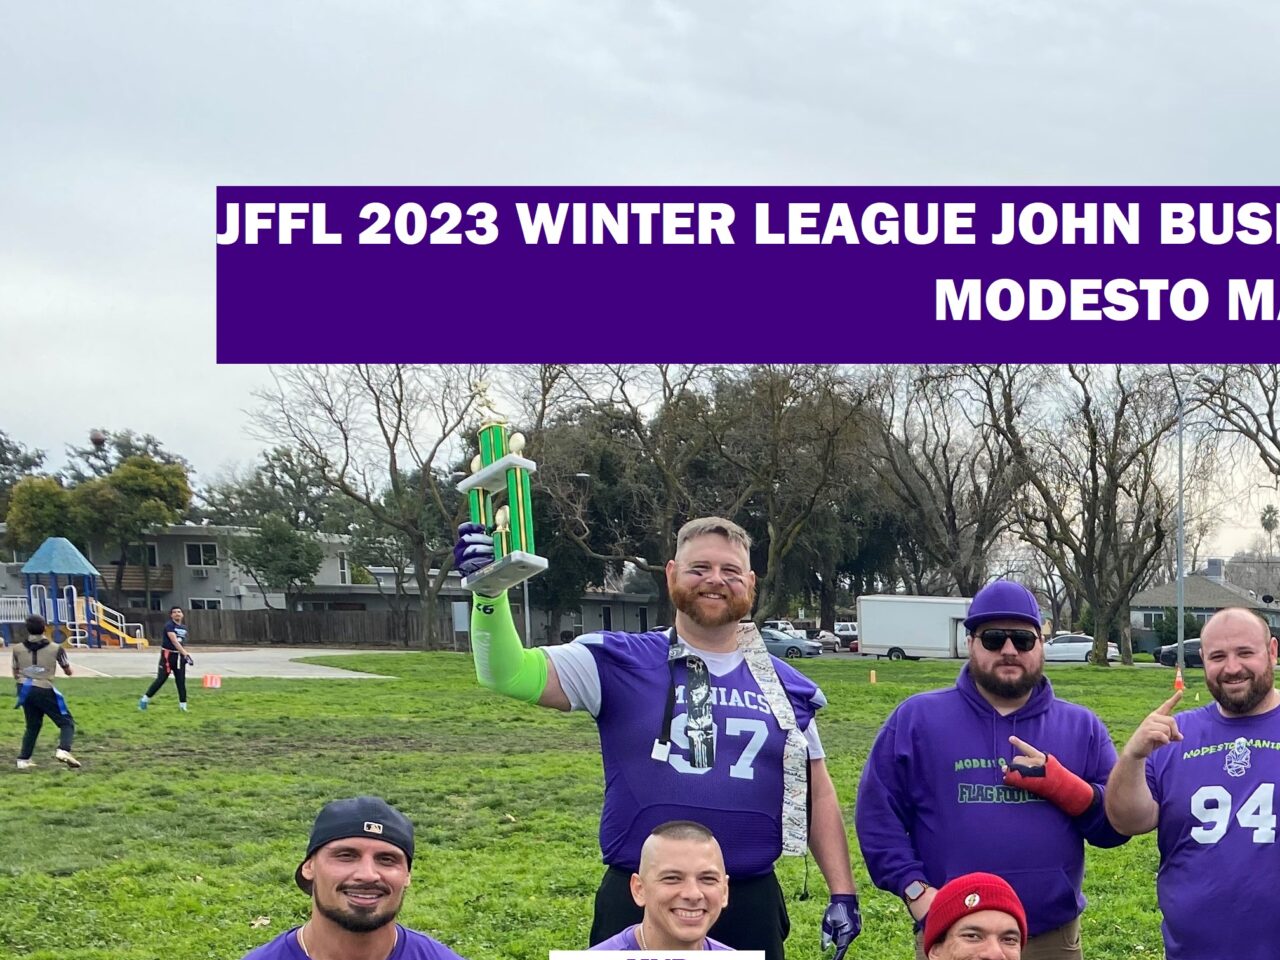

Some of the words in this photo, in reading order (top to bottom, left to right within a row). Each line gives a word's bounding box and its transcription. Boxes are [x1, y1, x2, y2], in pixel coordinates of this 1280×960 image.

[674, 685, 772, 715] MNIACS
[668, 713, 770, 780] 97
[957, 783, 997, 804] FLAG
[1190, 783, 1277, 844] 94
